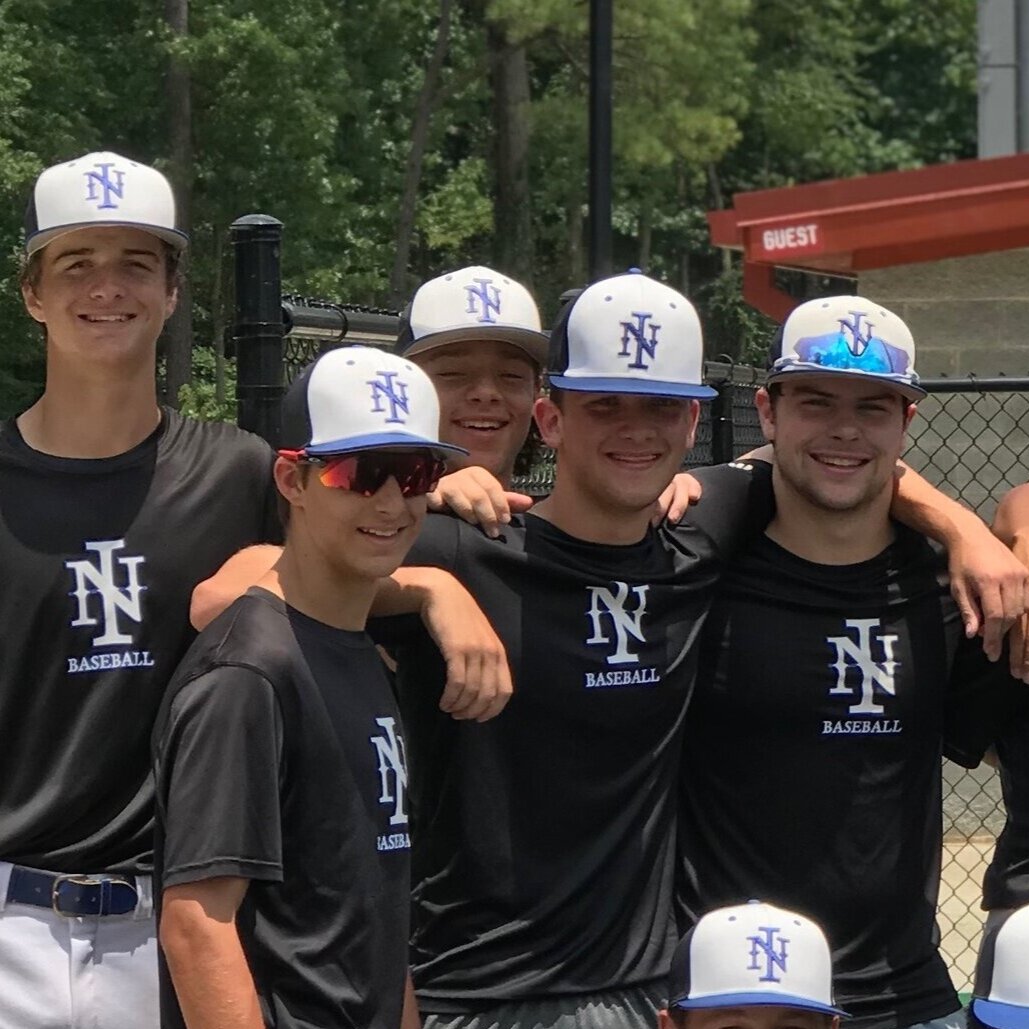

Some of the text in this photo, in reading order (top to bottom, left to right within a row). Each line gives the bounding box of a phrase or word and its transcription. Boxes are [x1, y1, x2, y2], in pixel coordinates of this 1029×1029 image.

[763, 224, 818, 251] GUEST
[67, 651, 155, 673] BASEBALL
[585, 669, 661, 689] BASEBALL
[822, 719, 903, 736] BASEBALL
